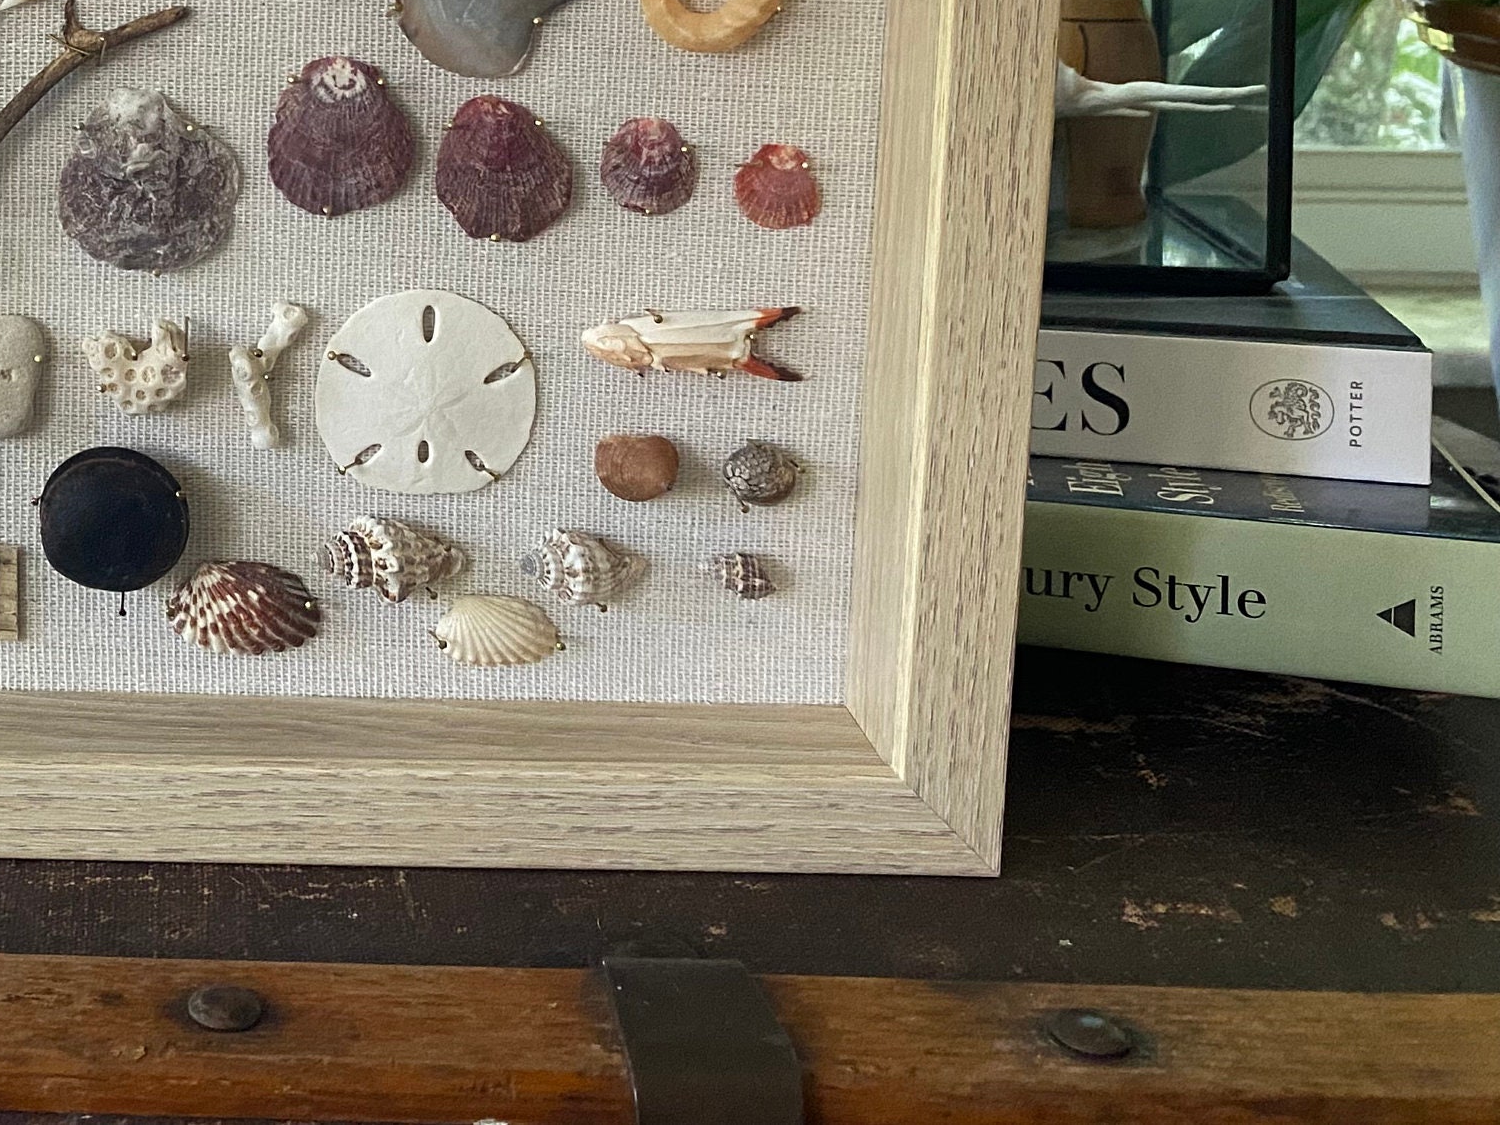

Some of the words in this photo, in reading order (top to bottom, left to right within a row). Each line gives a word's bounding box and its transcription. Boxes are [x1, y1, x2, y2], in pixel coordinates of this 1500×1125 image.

[1031, 359, 1130, 436] ES
[1349, 380, 1363, 448] POTTER
[1132, 566, 1267, 623] Style
[1429, 585, 1444, 655] ABRAMS
